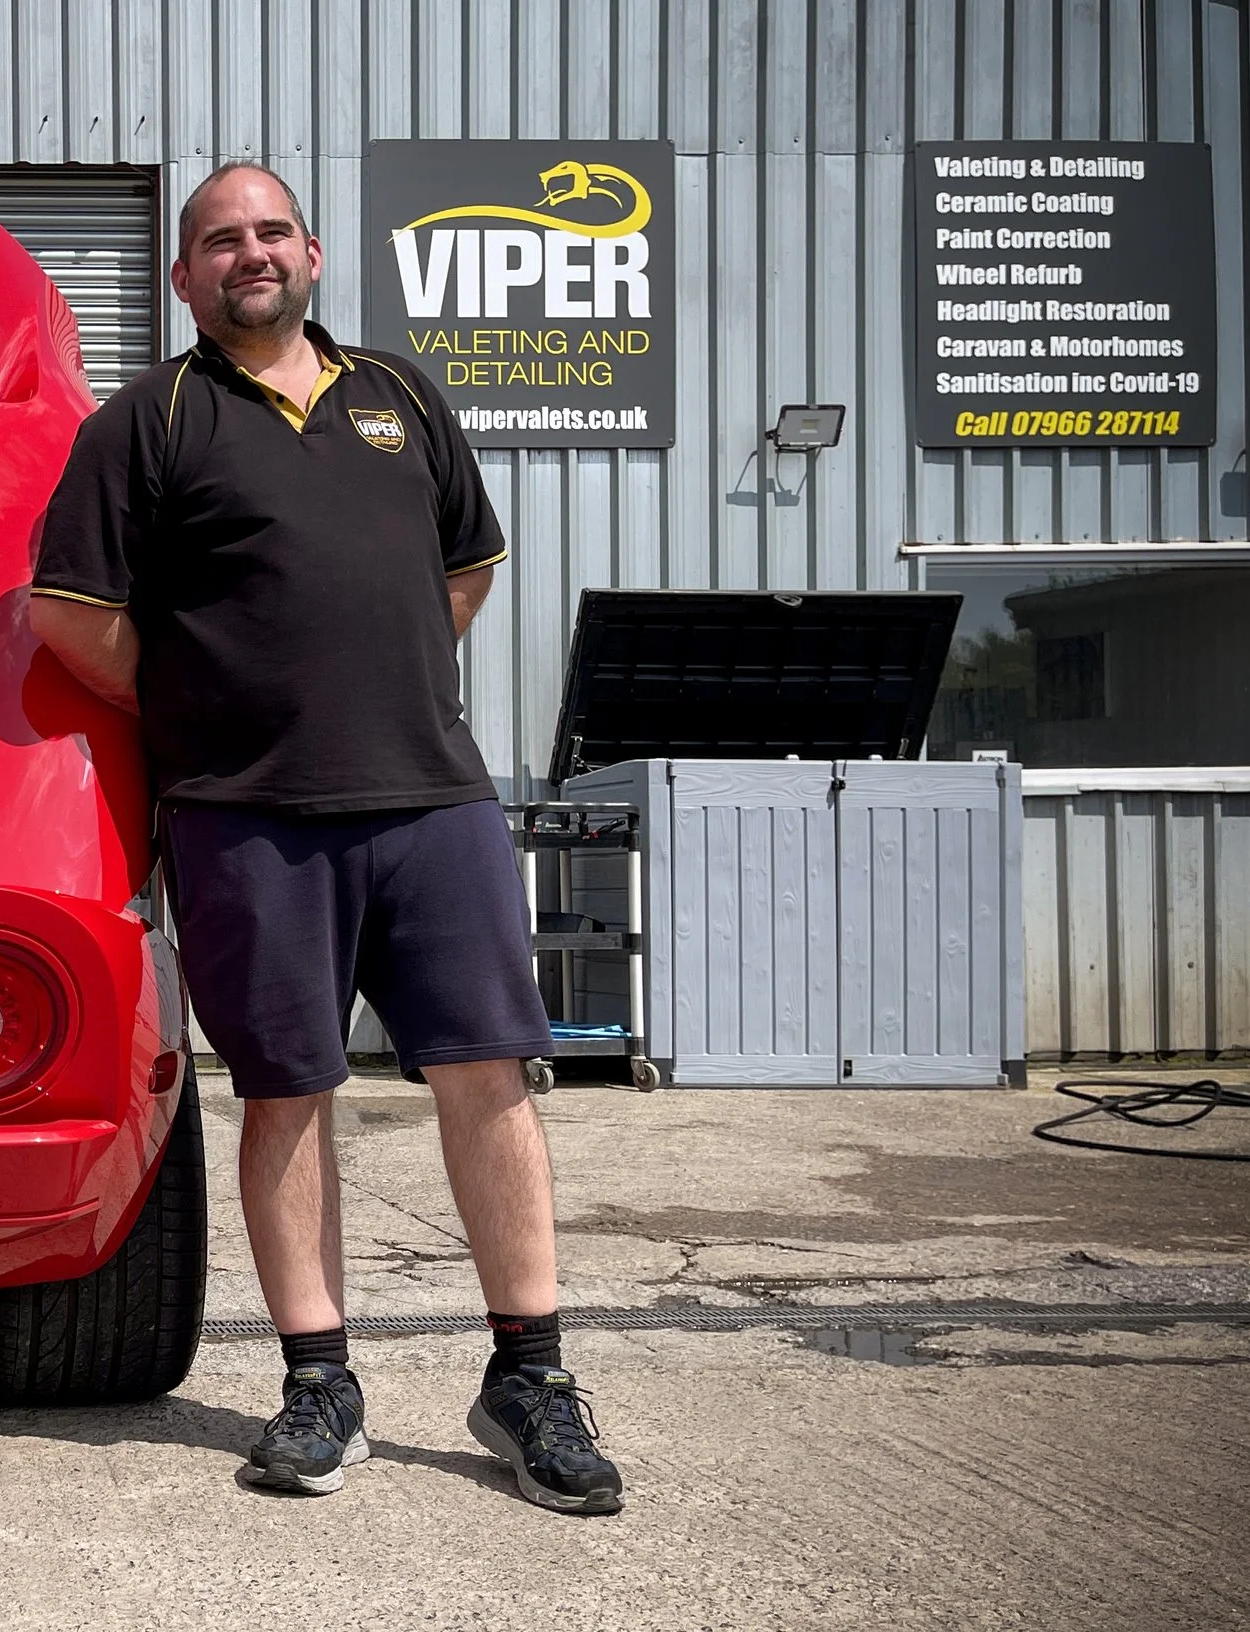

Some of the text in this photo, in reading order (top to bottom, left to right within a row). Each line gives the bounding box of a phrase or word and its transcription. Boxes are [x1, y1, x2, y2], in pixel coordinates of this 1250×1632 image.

[934, 156, 1145, 180] Valeting & Detailing
[935, 192, 1114, 215] Ceramic Coating
[936, 228, 1111, 249] Paint Correction
[391, 229, 653, 318] VIPER
[935, 264, 1083, 285] Wheel Refurb
[937, 300, 1170, 323] Headlight Restoration
[408, 330, 650, 355] VALETING AND
[936, 336, 1184, 357] Caravan & Motorhomes
[447, 362, 613, 386] DETAILING
[936, 372, 1200, 394] Sanitisation inc Covid-19
[356, 420, 402, 437] VIPER
[451, 405, 648, 431] vipervalets.co.uk
[955, 411, 1181, 436] Call 07966 287114
